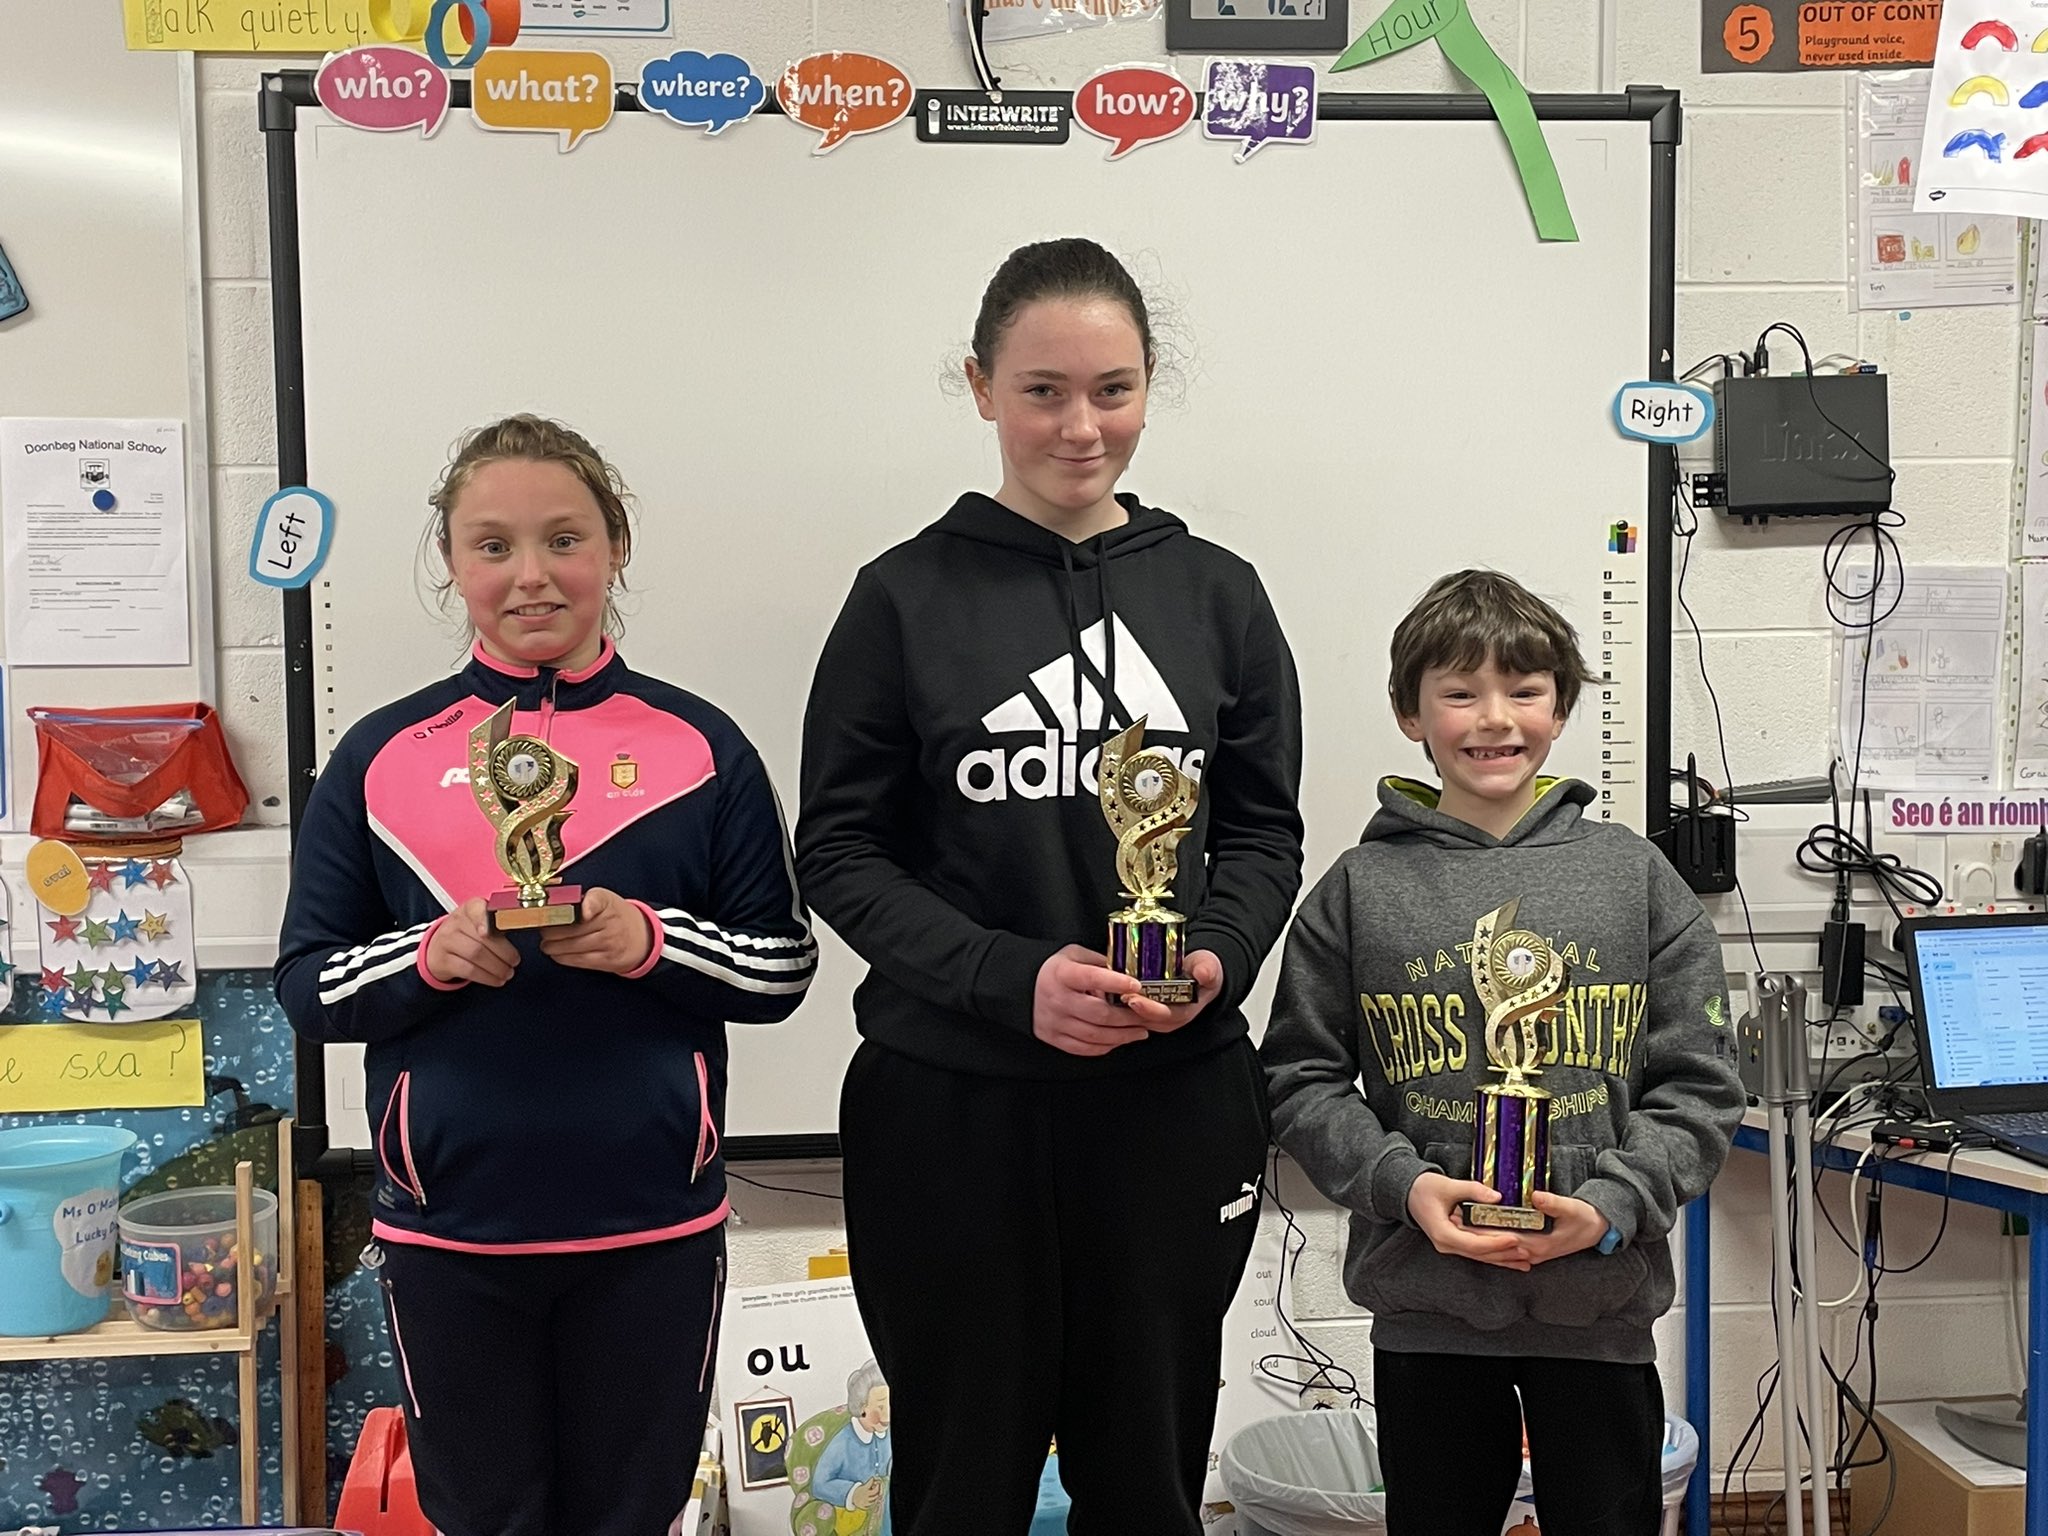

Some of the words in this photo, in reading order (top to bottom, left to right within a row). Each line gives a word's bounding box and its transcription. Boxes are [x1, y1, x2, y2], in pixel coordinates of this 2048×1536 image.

[240, 0, 368, 50] quietly.
[1367, 0, 1441, 55] Hour
[1803, 6, 1845, 22] OUT
[1851, 6, 1876, 22] OF
[1739, 16, 1760, 51] 5
[1804, 34, 1870, 48] Playground
[1873, 34, 1905, 46] voice,
[1805, 51, 1834, 62] never
[1838, 50, 1864, 61] used
[1867, 50, 1904, 60] inside.
[334, 69, 433, 101] who?
[485, 70, 600, 105] what?
[651, 73, 751, 99] where?
[793, 76, 905, 108] when?
[946, 104, 1059, 123] INTERWRITE
[1094, 86, 1186, 116] how?
[1217, 86, 1308, 123] why?
[1630, 398, 1694, 428] Right
[24, 440, 76, 455] Doonbeg
[78, 439, 125, 451] National
[127, 440, 167, 455] School
[267, 511, 306, 570] Left
[1892, 798, 1934, 827] Seo
[1939, 796, 1953, 827] é
[1957, 802, 1984, 826] an
[1405, 940, 1602, 982] NATAL
[1359, 992, 1467, 1086] CROSS
[1488, 982, 1649, 1080] NTRY
[60, 1050, 142, 1080] sea
[1405, 1083, 1609, 1124] CHAMSHIPS
[63, 1206, 82, 1219] Ms
[1220, 1193, 1254, 1223] PUMA
[76, 1227, 108, 1244] Lucky
[1255, 1269, 1273, 1280] out
[1250, 1325, 1278, 1339] cloud
[746, 1343, 811, 1376] ou
